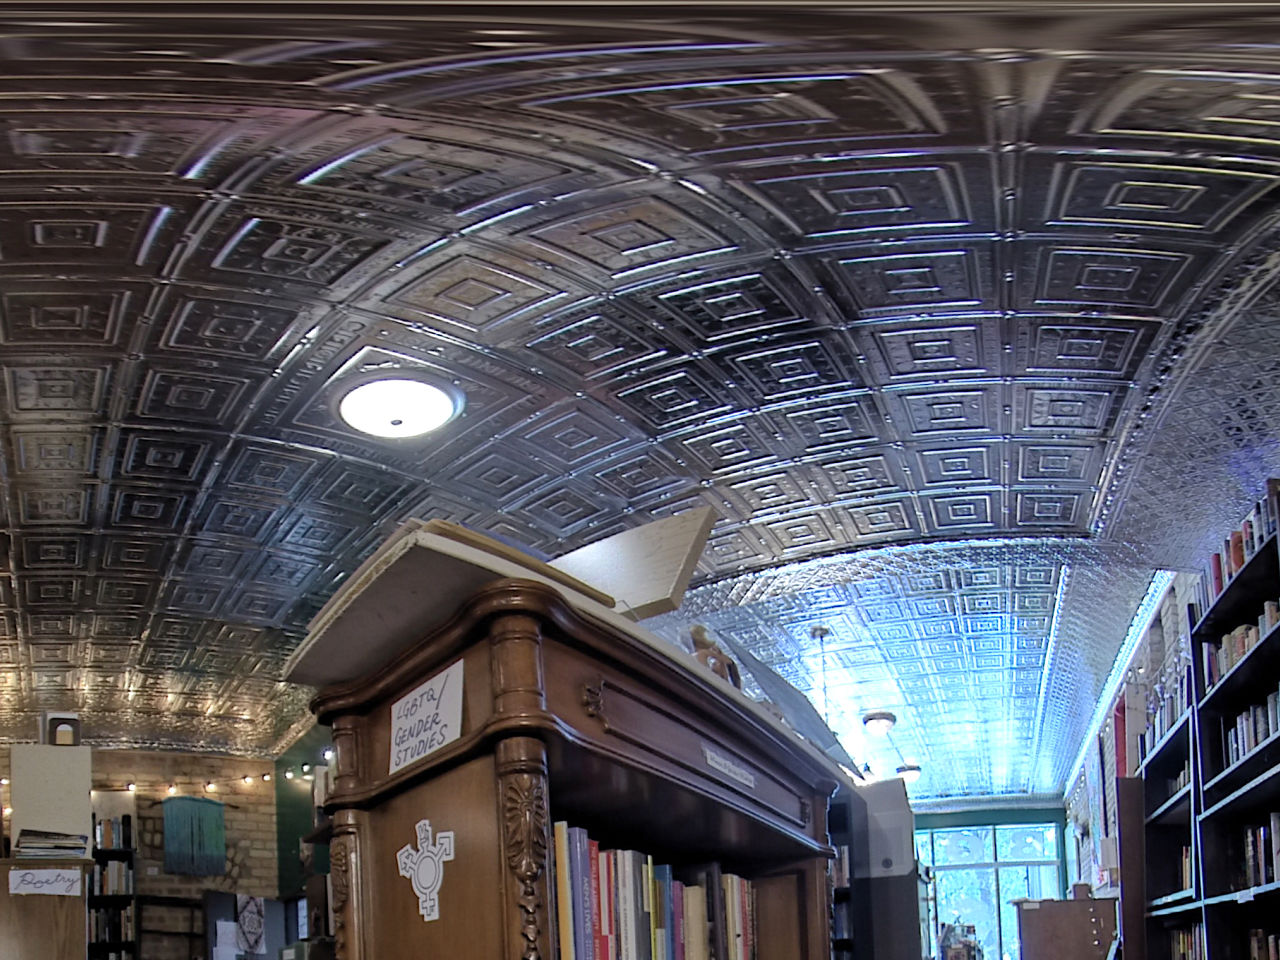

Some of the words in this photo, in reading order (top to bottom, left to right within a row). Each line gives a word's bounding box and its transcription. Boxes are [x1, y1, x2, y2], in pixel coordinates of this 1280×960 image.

[396, 673, 449, 721] LGBTQ/
[393, 724, 449, 768] STUDIES
[394, 712, 442, 748] GENDER
[16, 871, 81, 894] Poetry
